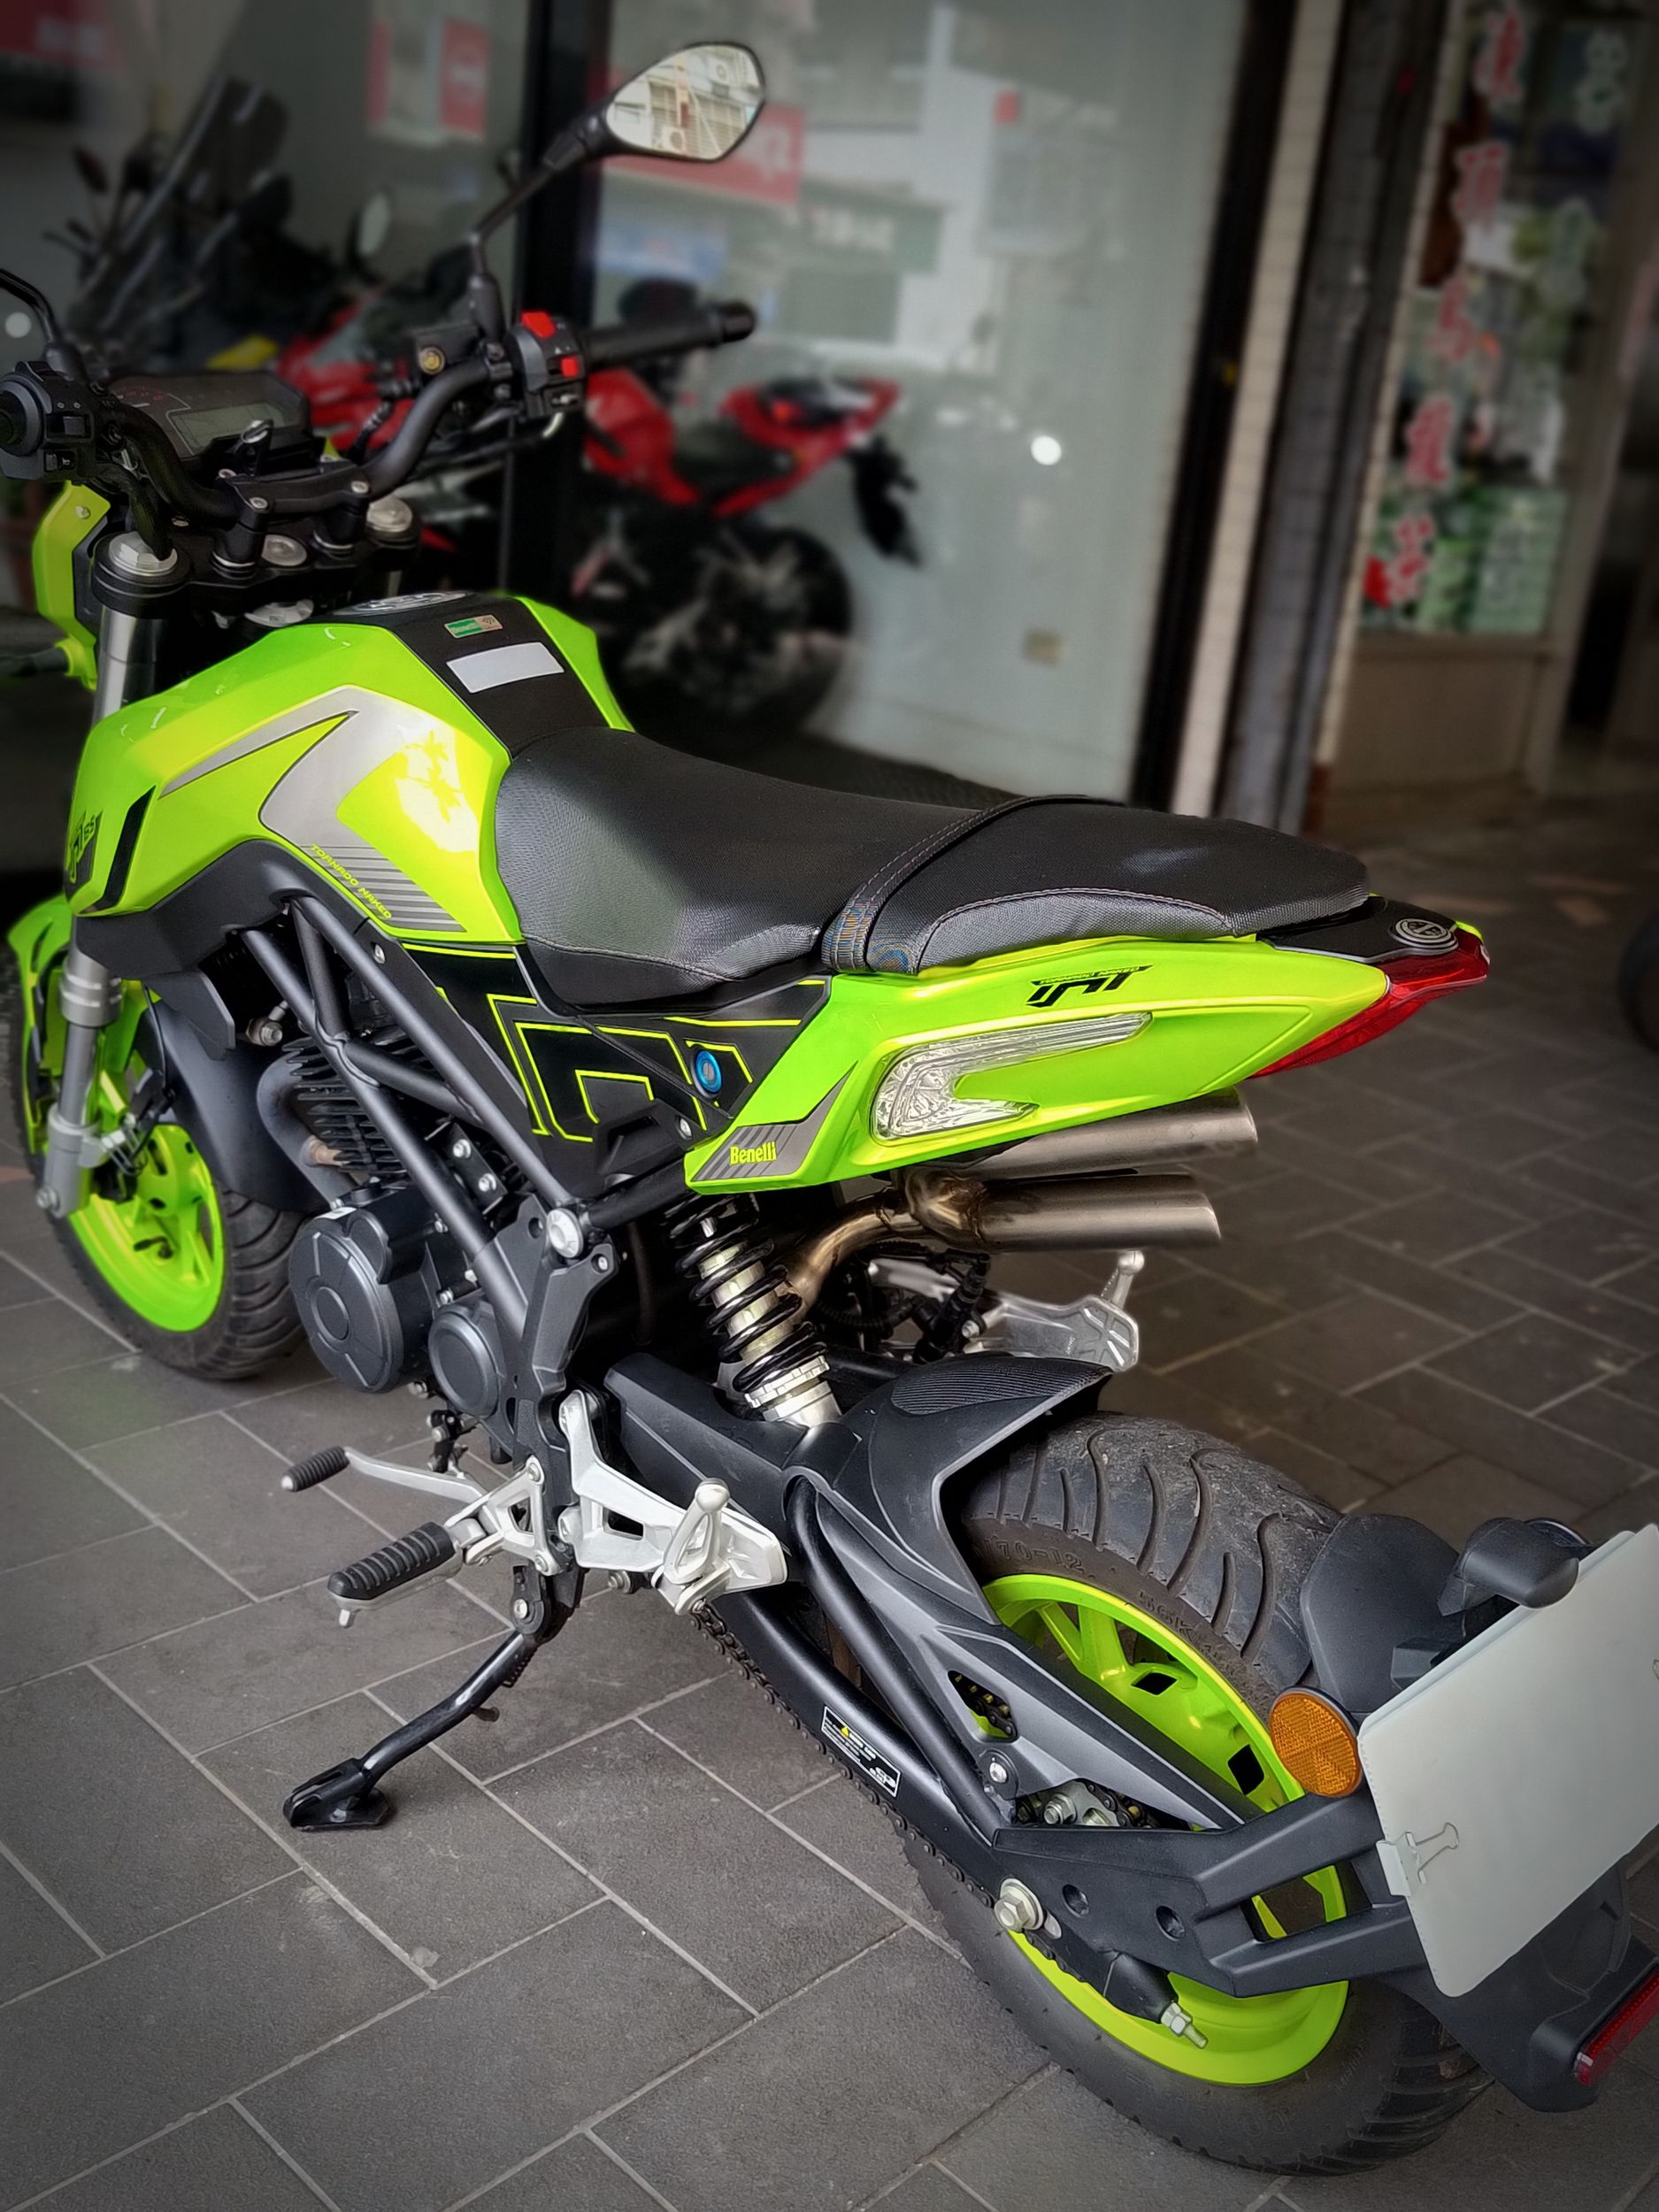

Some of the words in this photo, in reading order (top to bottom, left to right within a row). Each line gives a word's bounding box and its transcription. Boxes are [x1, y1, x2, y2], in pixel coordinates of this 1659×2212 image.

[311, 843, 359, 887] TORNADO
[357, 887, 392, 918] NAKED
[730, 1141, 777, 1165] Benelli
